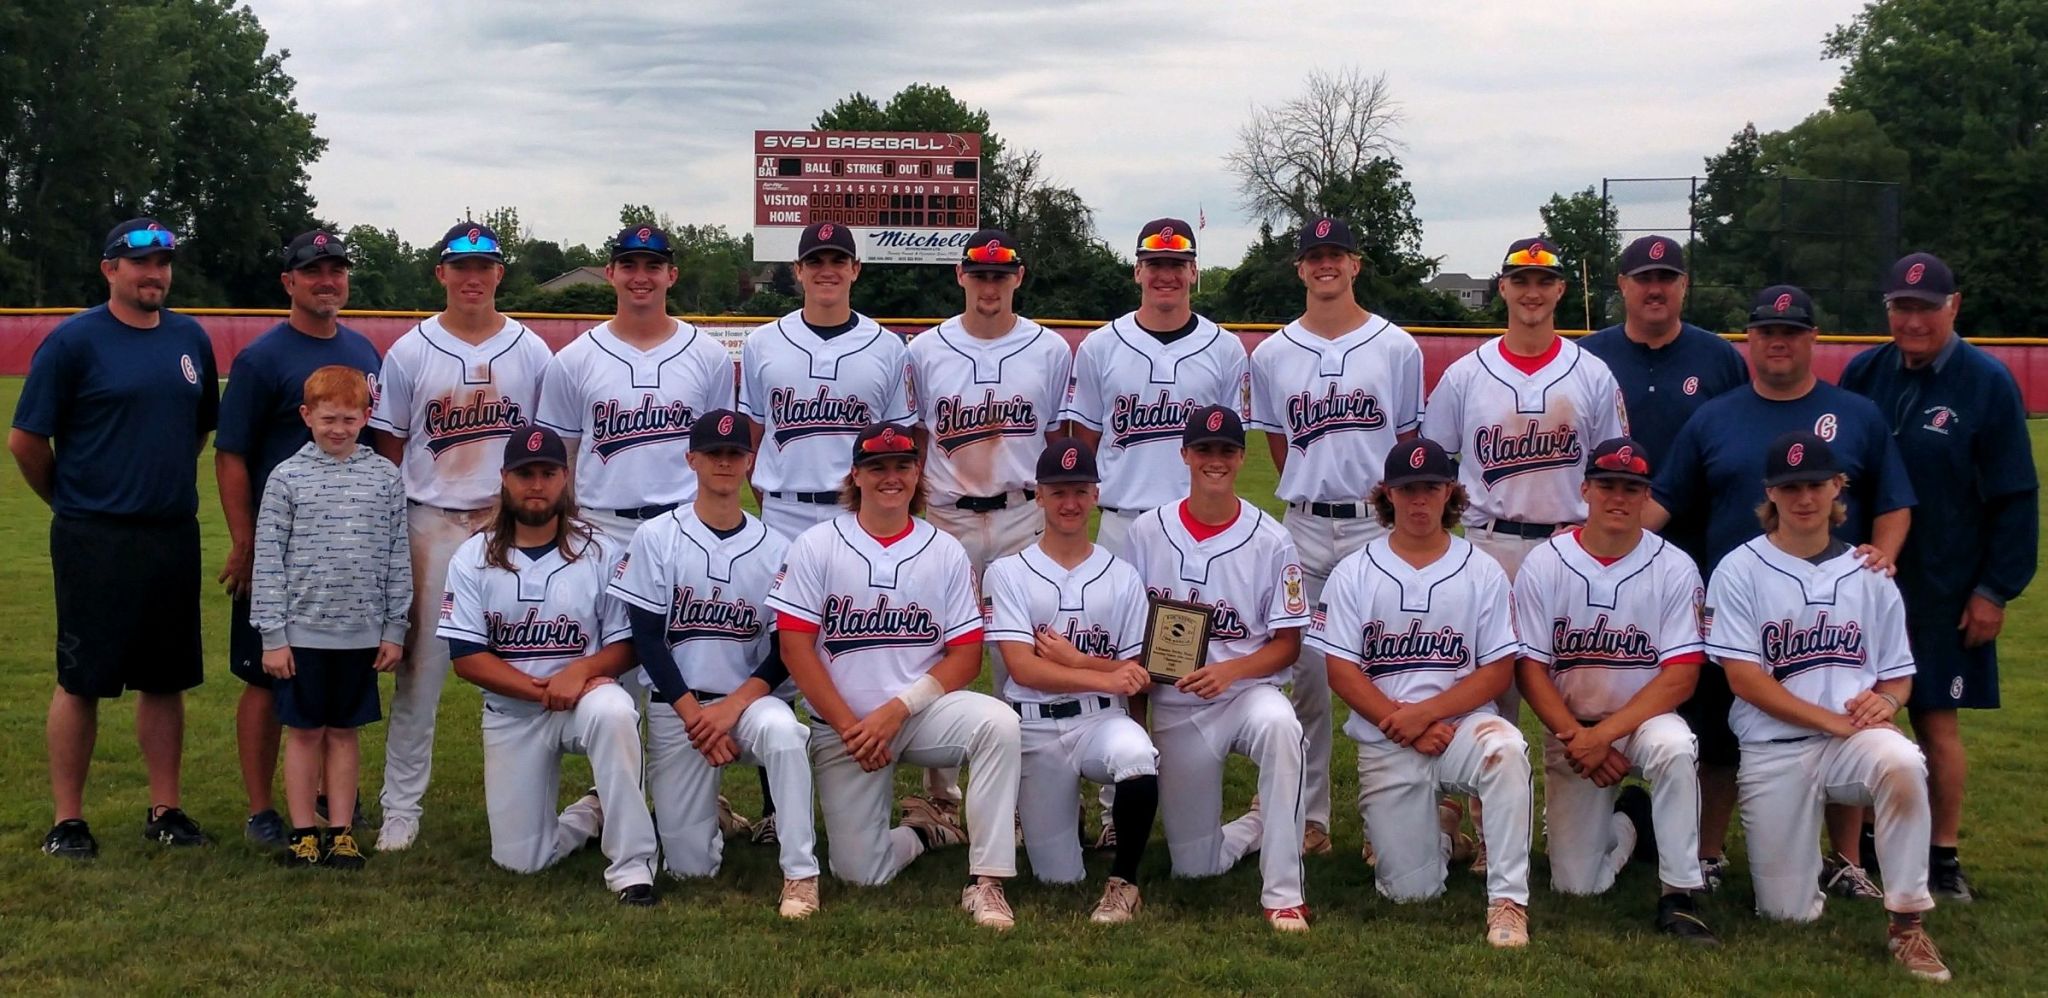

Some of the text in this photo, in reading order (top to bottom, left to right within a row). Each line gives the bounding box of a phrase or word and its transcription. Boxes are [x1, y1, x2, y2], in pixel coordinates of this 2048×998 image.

[763, 136, 944, 150] SVSU BASEBALL
[758, 167, 778, 177] BAT
[762, 158, 775, 167] AT
[805, 163, 831, 173] BALL
[846, 164, 883, 174] STRIKE
[899, 164, 919, 174] OUT
[936, 164, 953, 174] H/E
[763, 194, 808, 206] VISITOR
[893, 186, 898, 194] 8
[770, 212, 801, 222] HOME
[818, 224, 834, 240] G
[869, 231, 970, 246] Mitchell
[1316, 220, 1331, 238] G
[1649, 241, 1665, 260] G
[1906, 262, 1925, 284] G
[180, 354, 197, 384] G
[1682, 376, 1699, 396] G
[592, 394, 695, 441] Gladwin
[770, 385, 871, 431] Gladwin
[934, 389, 1038, 436] Gladwin
[1111, 390, 1203, 435] Gladwi
[1286, 382, 1386, 434] Gladwin
[718, 415, 734, 435] G
[1207, 411, 1224, 432] G
[1814, 413, 1838, 442] G
[527, 431, 543, 451] G
[1474, 420, 1581, 468] Gladwin
[1062, 448, 1078, 470] G
[1410, 447, 1426, 469] G
[1787, 444, 1804, 466] G
[822, 594, 940, 638] Gladwin
